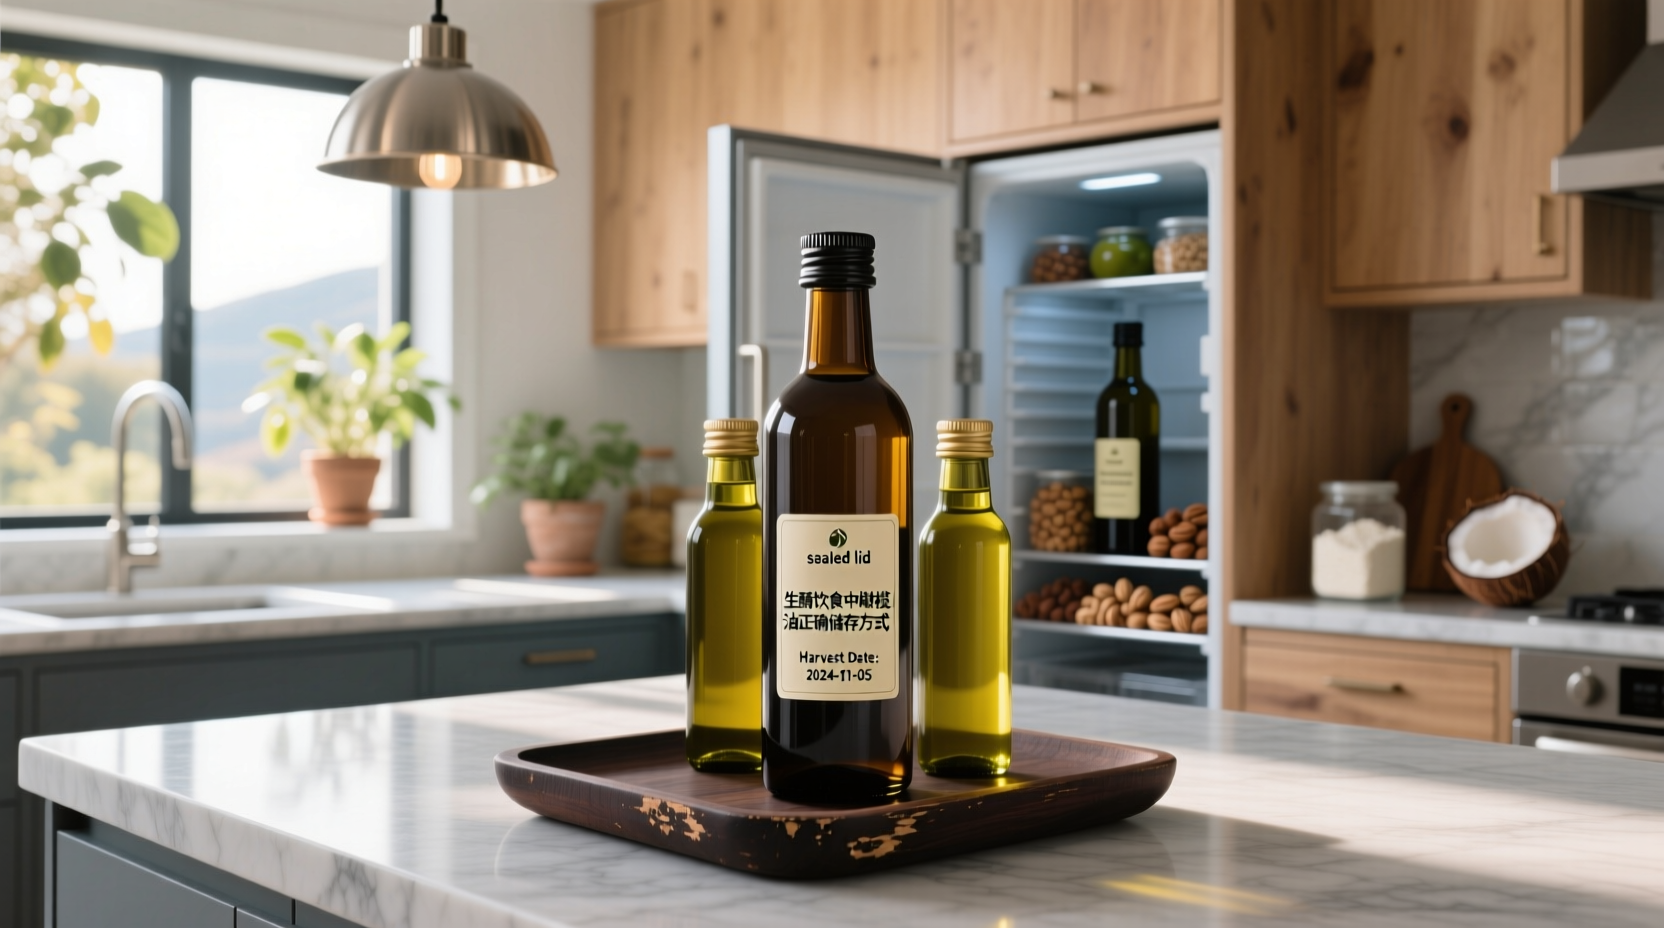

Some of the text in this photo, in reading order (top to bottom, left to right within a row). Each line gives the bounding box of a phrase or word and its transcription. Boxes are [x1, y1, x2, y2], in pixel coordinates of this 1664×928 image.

[855, 550, 871, 565] lid
[799, 651, 879, 664] Harvest Date:
[806, 669, 872, 682] 2024-11-05
